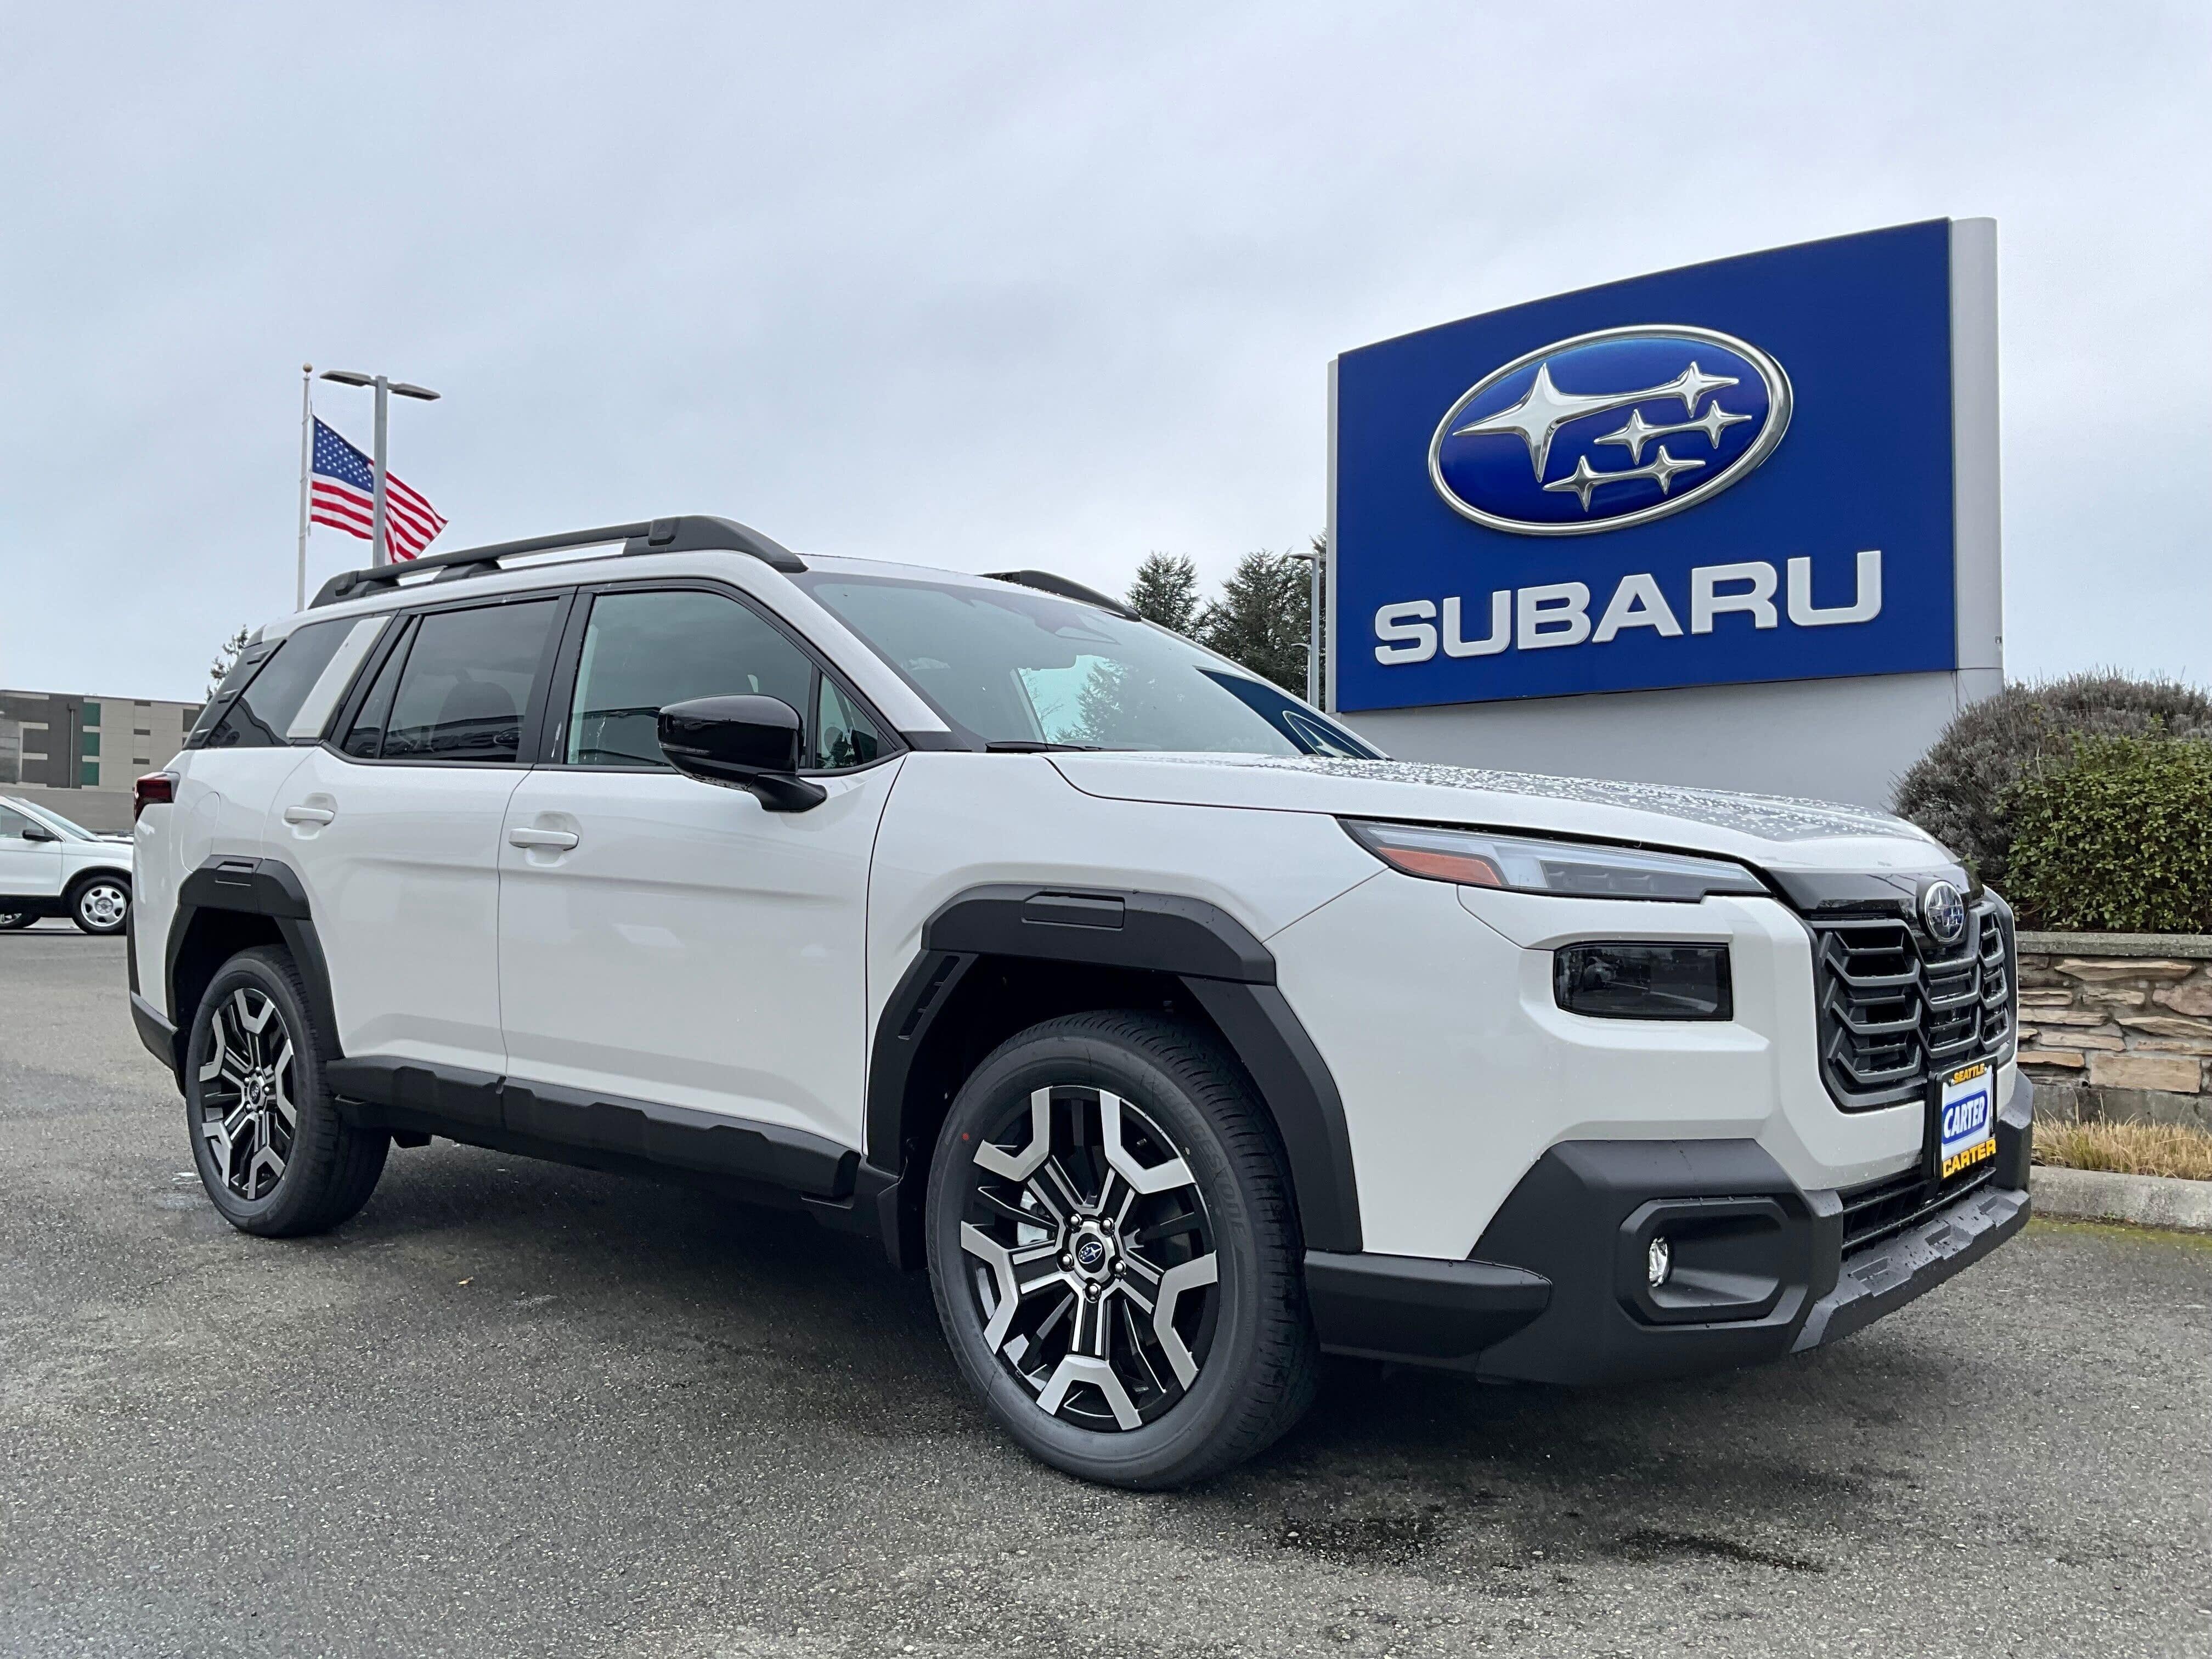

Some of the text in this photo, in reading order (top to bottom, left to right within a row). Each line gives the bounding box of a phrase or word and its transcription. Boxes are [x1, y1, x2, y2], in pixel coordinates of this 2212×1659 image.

[1375, 550, 1882, 665] SUBARU
[1954, 1063, 1985, 1084] SEATTLE
[1944, 1096, 1985, 1138] CARTER
[1943, 1138, 1996, 1178] CARTER
